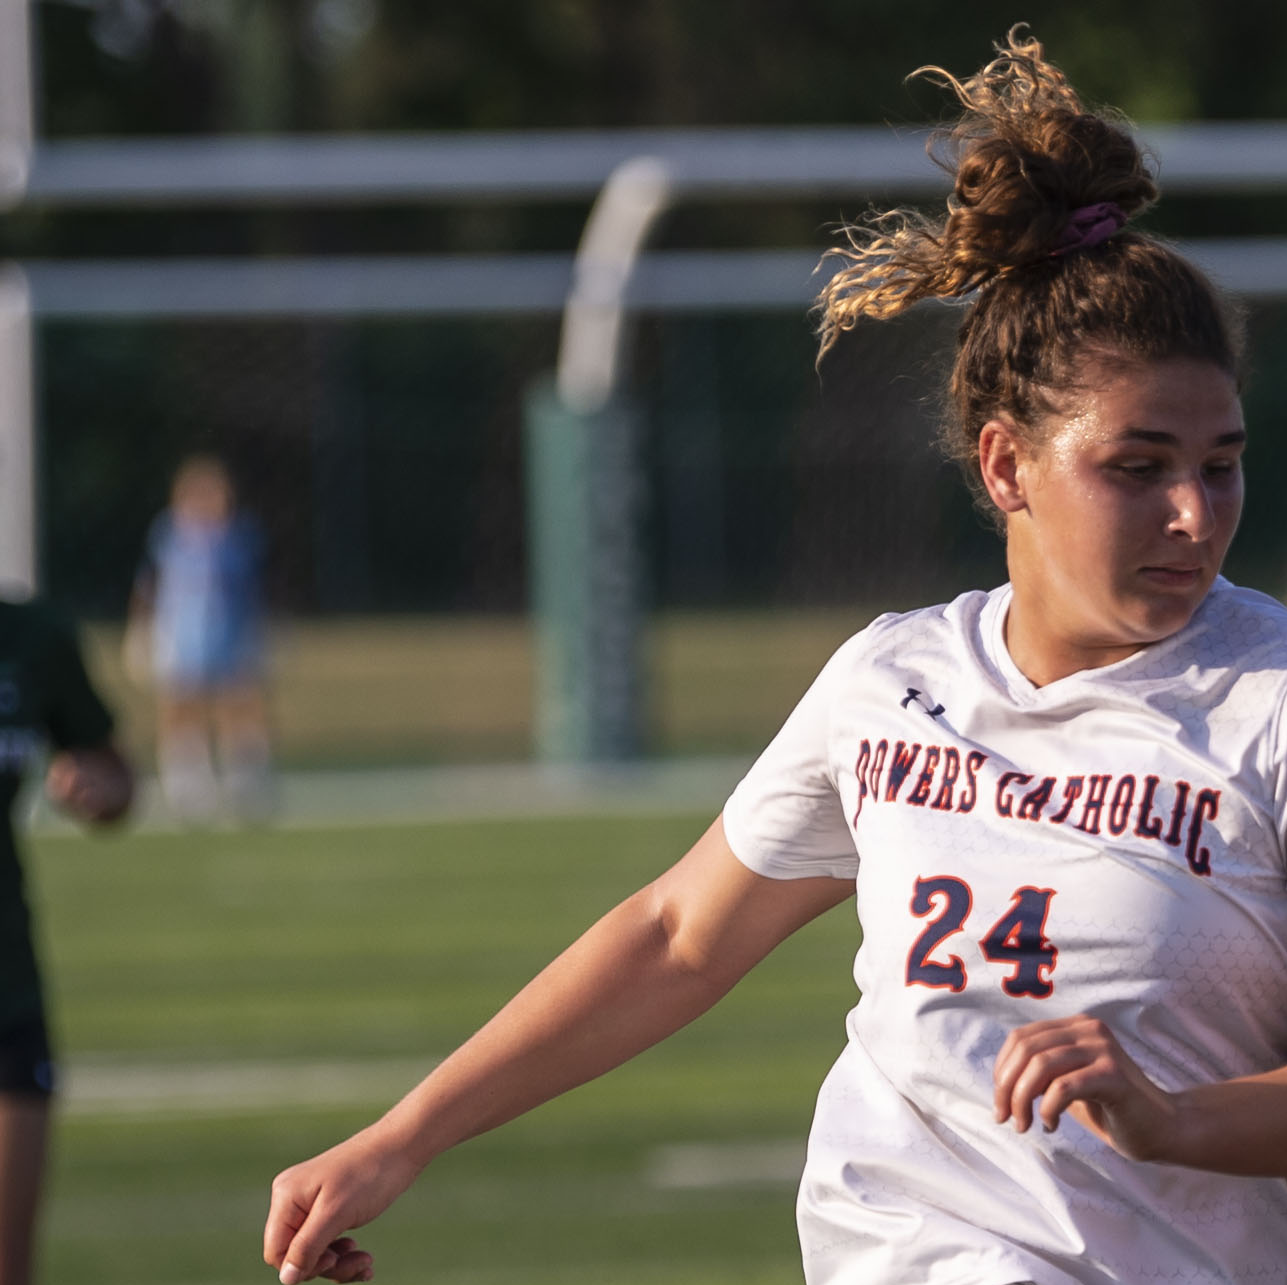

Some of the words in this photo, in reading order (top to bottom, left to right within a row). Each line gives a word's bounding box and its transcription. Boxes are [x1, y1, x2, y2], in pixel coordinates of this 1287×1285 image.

[854, 738, 989, 832] POWERS
[995, 771, 1222, 877] CATHOLIC
[904, 874, 1059, 999] 24
